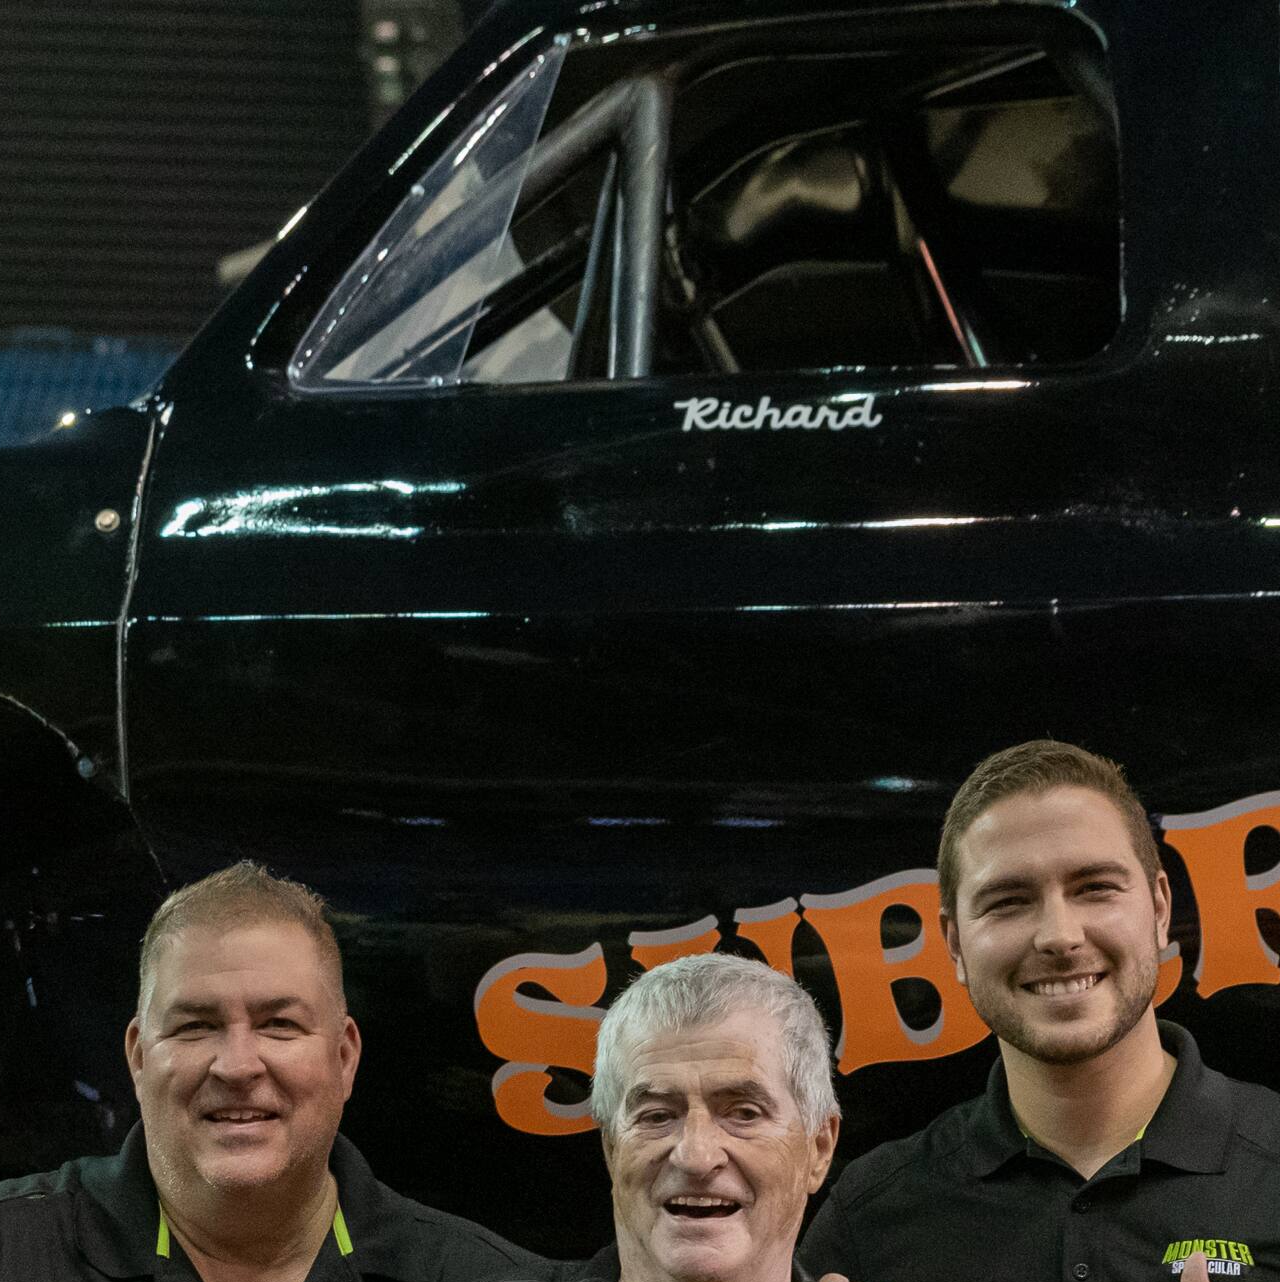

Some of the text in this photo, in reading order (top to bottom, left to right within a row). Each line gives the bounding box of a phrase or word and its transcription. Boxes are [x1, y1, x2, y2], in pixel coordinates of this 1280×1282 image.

[674, 393, 883, 432] Richard
[1162, 1239, 1255, 1267] MONSTER
[1171, 1260, 1241, 1276] SPCULAR
